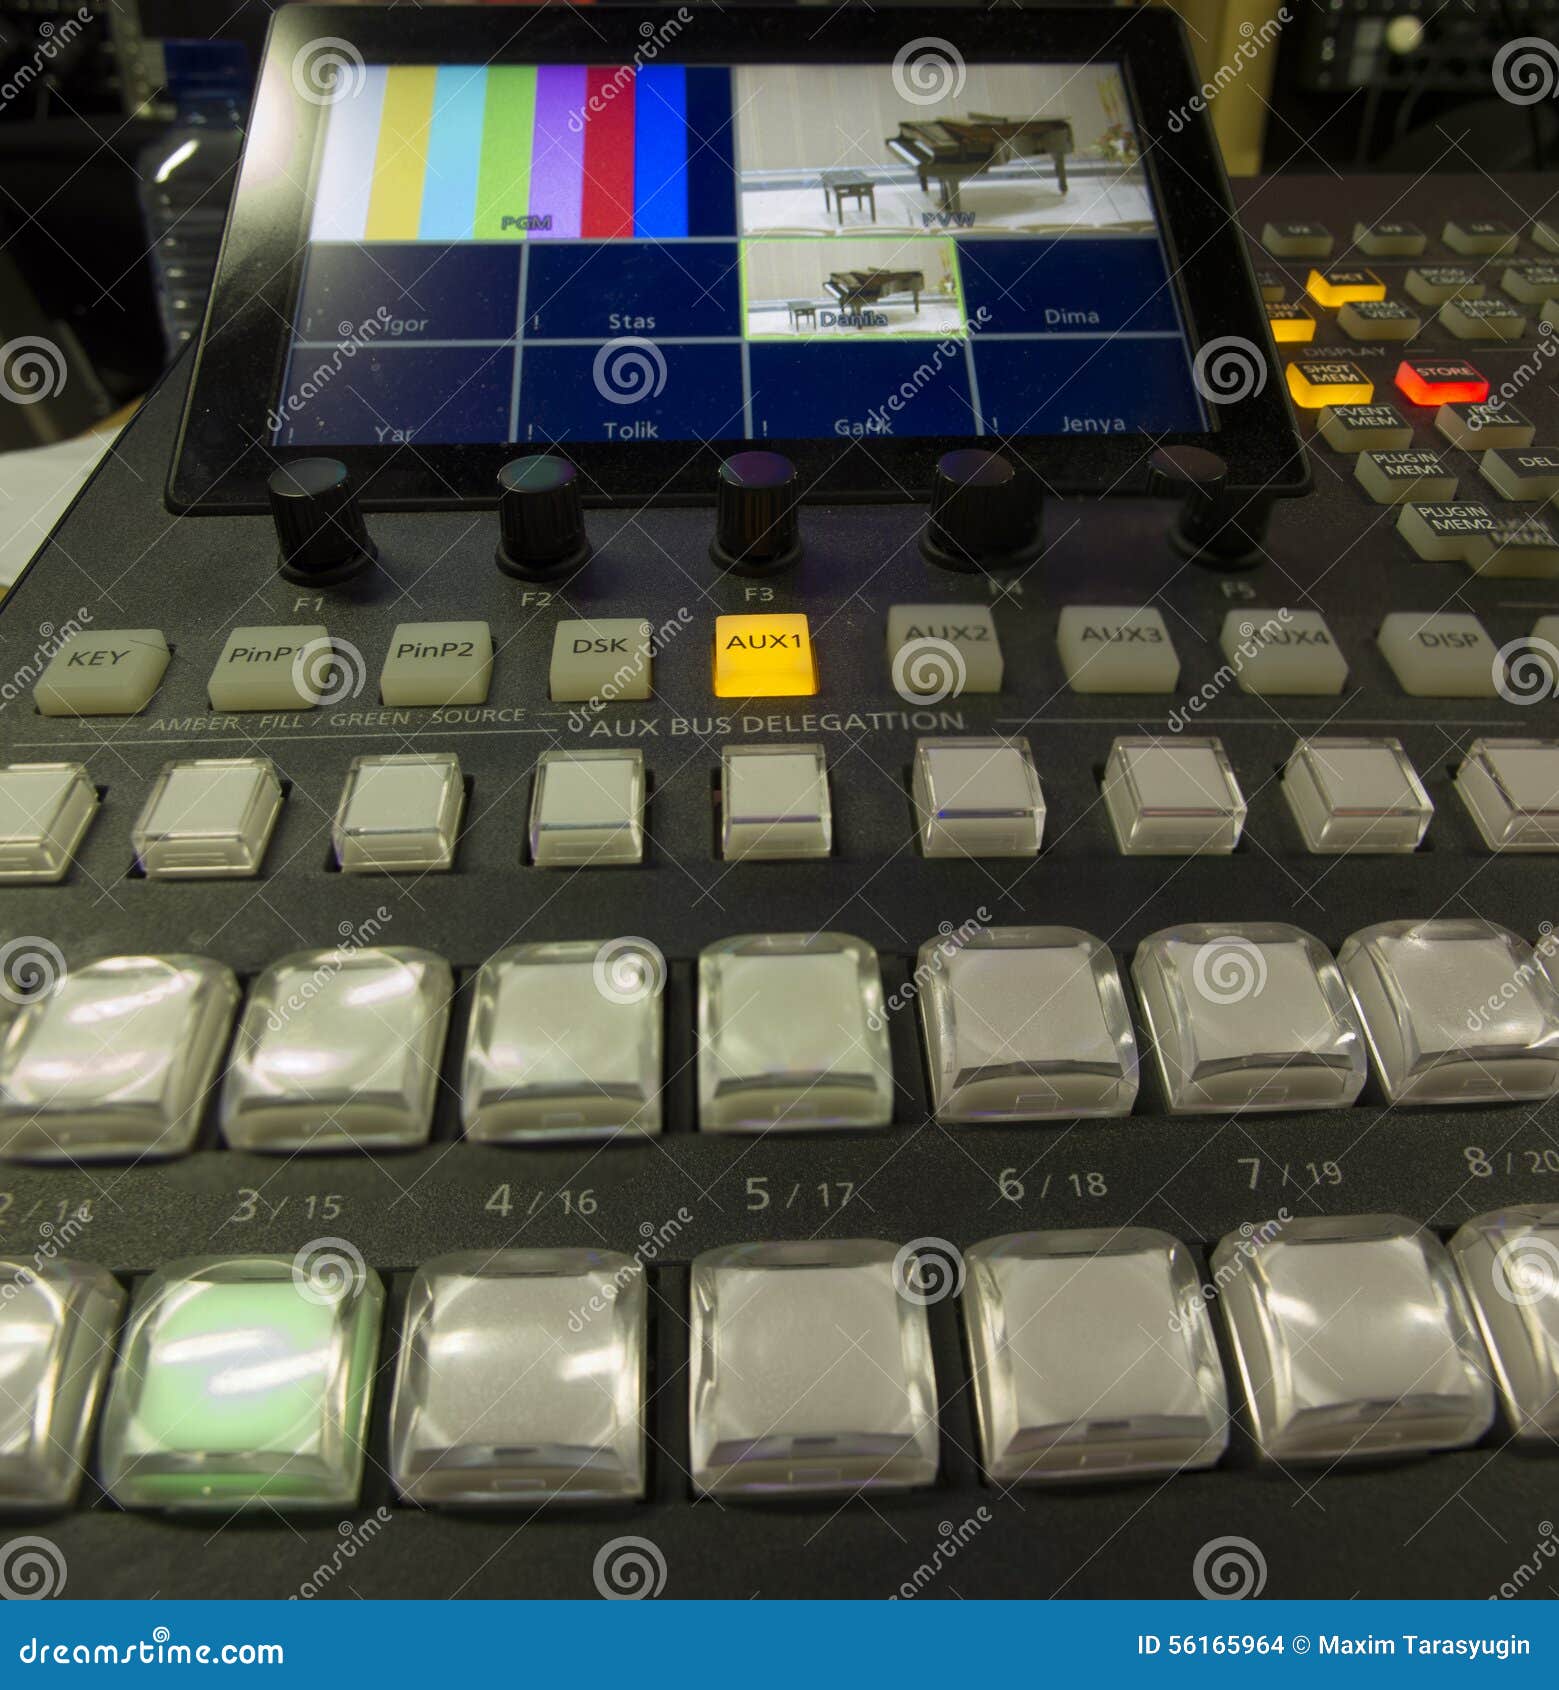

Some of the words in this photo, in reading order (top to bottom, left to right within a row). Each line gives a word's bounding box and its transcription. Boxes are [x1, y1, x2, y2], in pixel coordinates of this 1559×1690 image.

[501, 215, 554, 230] PGM
[922, 211, 976, 227] PVW
[608, 313, 656, 329] Stas
[820, 311, 889, 328] Danila
[1045, 308, 1100, 324] Dima
[1303, 347, 1385, 357] DISPLAY
[1302, 364, 1350, 374] SHOT
[1416, 367, 1475, 377] STORE
[1311, 373, 1360, 383] MEM
[1333, 406, 1392, 416] EVENT
[1062, 416, 1126, 434] Jenya
[1347, 416, 1399, 426] MEM
[375, 426, 415, 443] Yar
[603, 421, 659, 439] Tolik
[1385, 465, 1444, 476] MEM1
[1431, 518, 1497, 531] MEM2
[744, 588, 775, 602] F3
[1221, 581, 1256, 599] F5
[292, 597, 325, 612] F1
[521, 592, 552, 607] F2
[905, 624, 990, 642] AUX2
[1081, 626, 1163, 643] AUX3
[1419, 632, 1479, 648] DISP
[397, 641, 475, 659] PinP2
[572, 637, 629, 654] DSK
[726, 634, 802, 650] AUX1
[67, 650, 132, 667] KEY
[149, 716, 239, 732] AMBER
[259, 715, 302, 729] FILL
[329, 711, 411, 727] GREEN
[430, 708, 527, 725] SOURCE
[590, 719, 660, 738] AUX
[670, 716, 732, 736] BUS
[743, 711, 965, 734] DELEGATTION
[1463, 1146, 1493, 1178] 8
[1506, 1152, 1513, 1175] /
[1237, 1157, 1261, 1190] 7
[1281, 1163, 1289, 1187] /
[1305, 1161, 1343, 1185] 19
[999, 1167, 1025, 1201] 6
[1040, 1175, 1052, 1198] /
[1068, 1172, 1109, 1198] 18
[484, 1183, 514, 1217] 4
[527, 1191, 544, 1214] /
[560, 1189, 599, 1216] 16
[745, 1177, 770, 1211] 5
[786, 1183, 800, 1208] /
[817, 1182, 854, 1208] 17
[231, 1188, 259, 1222] 3
[269, 1196, 289, 1222] /
[304, 1195, 343, 1220] 15
